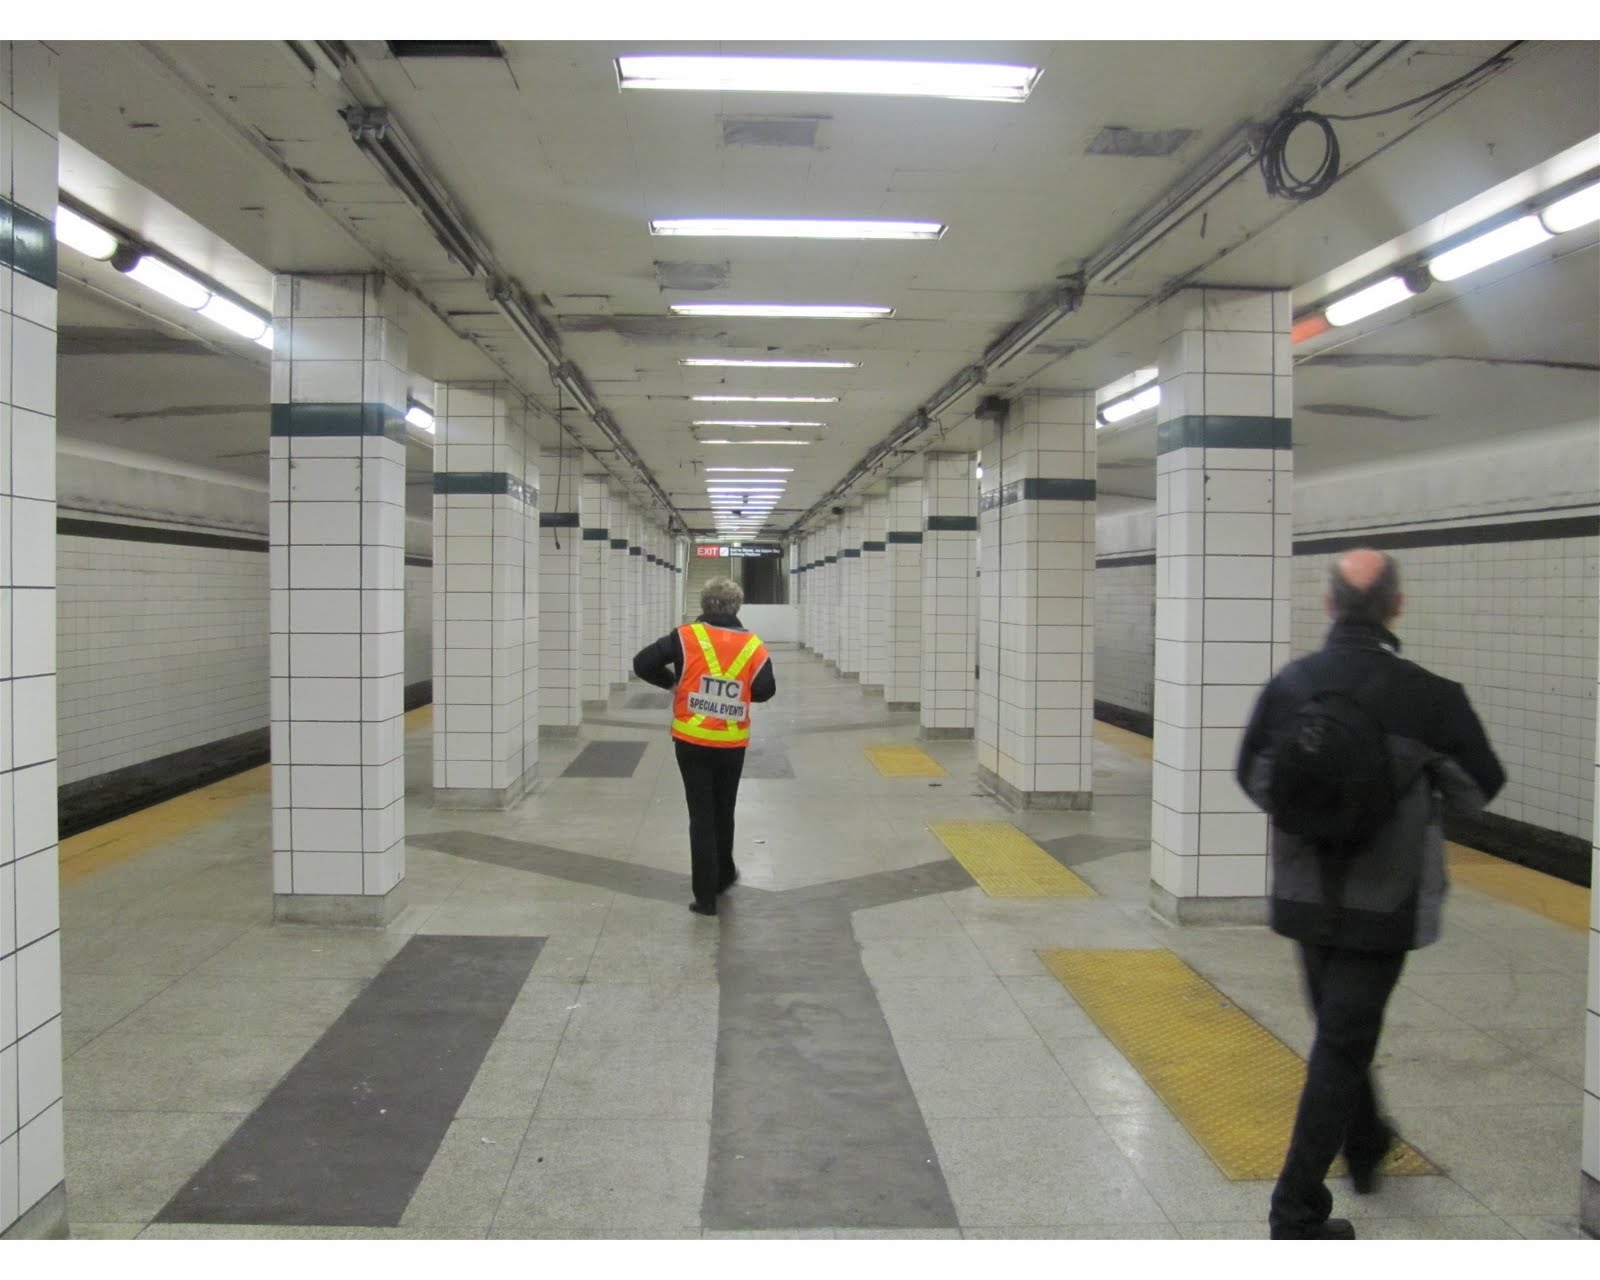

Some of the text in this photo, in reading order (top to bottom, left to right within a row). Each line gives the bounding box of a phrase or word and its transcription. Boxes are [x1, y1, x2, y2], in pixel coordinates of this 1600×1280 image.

[697, 547, 718, 556] EXIT
[703, 677, 740, 699] TTC
[690, 697, 744, 717] SPECIAL EVENTS
